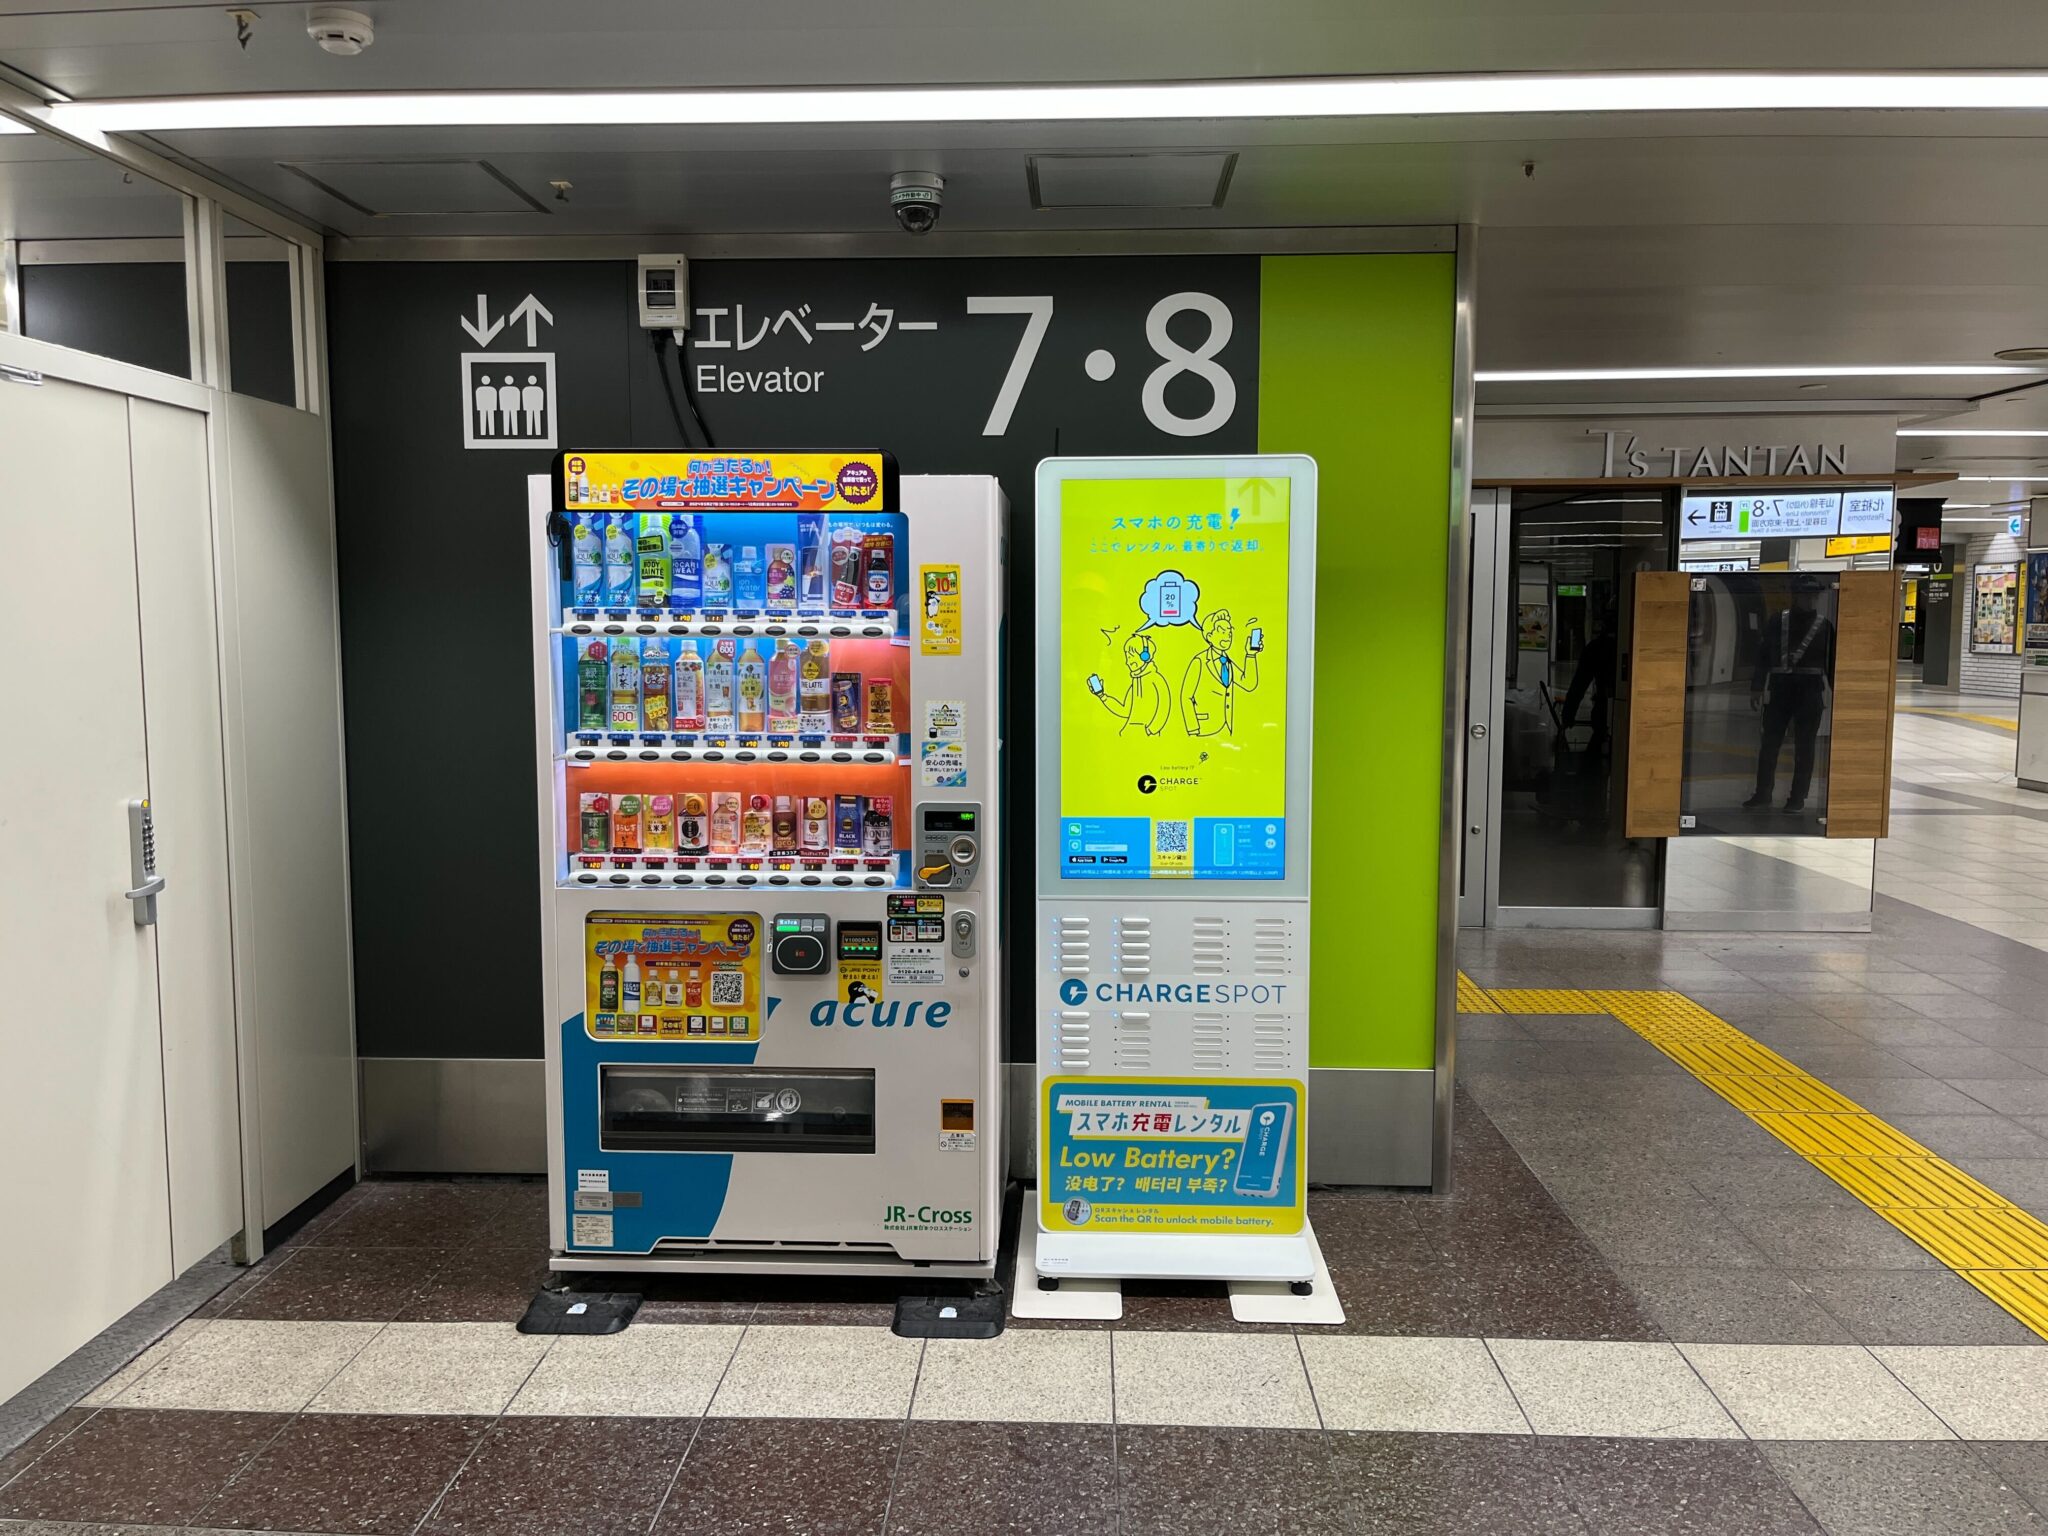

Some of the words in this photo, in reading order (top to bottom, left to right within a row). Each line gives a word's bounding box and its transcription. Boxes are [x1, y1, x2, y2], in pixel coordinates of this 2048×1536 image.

[694, 302, 938, 351] エレベーター
[696, 364, 825, 393] Elevator
[621, 477, 836, 500] その場で抽選キャンペーン
[643, 560, 661, 568] BODY
[719, 645, 735, 654] 600
[1160, 777, 1199, 785] CHARGE
[647, 824, 668, 832] 玄米茶
[595, 940, 751, 957] その場で抽選キャンペーン
[1096, 983, 1287, 1004] CHARGESPOT
[810, 1000, 951, 1029] acure
[1065, 1099, 1099, 1107] MOBILE
[1100, 1100, 1137, 1108] BATTERY
[1139, 1100, 1172, 1108] RENTAL
[1077, 1112, 1241, 1133] スマホ充電レンタル
[1259, 1127, 1271, 1157] CHARGE
[1060, 1146, 1115, 1168] Low
[1124, 1146, 1236, 1175] Battery?
[1065, 1175, 1124, 1192] 没电了?
[1135, 1176, 1181, 1193] 배터리
[1186, 1178, 1227, 1194] 부족?
[884, 1206, 973, 1223] JR-Cross
[1095, 1214, 1118, 1223] Scan
[1120, 1214, 1135, 1223] the
[1137, 1215, 1152, 1224] QR
[1154, 1215, 1164, 1224] to
[1166, 1215, 1198, 1224] unlock
[1200, 1215, 1234, 1225] mobile
[1235, 1216, 1274, 1227] battery.
